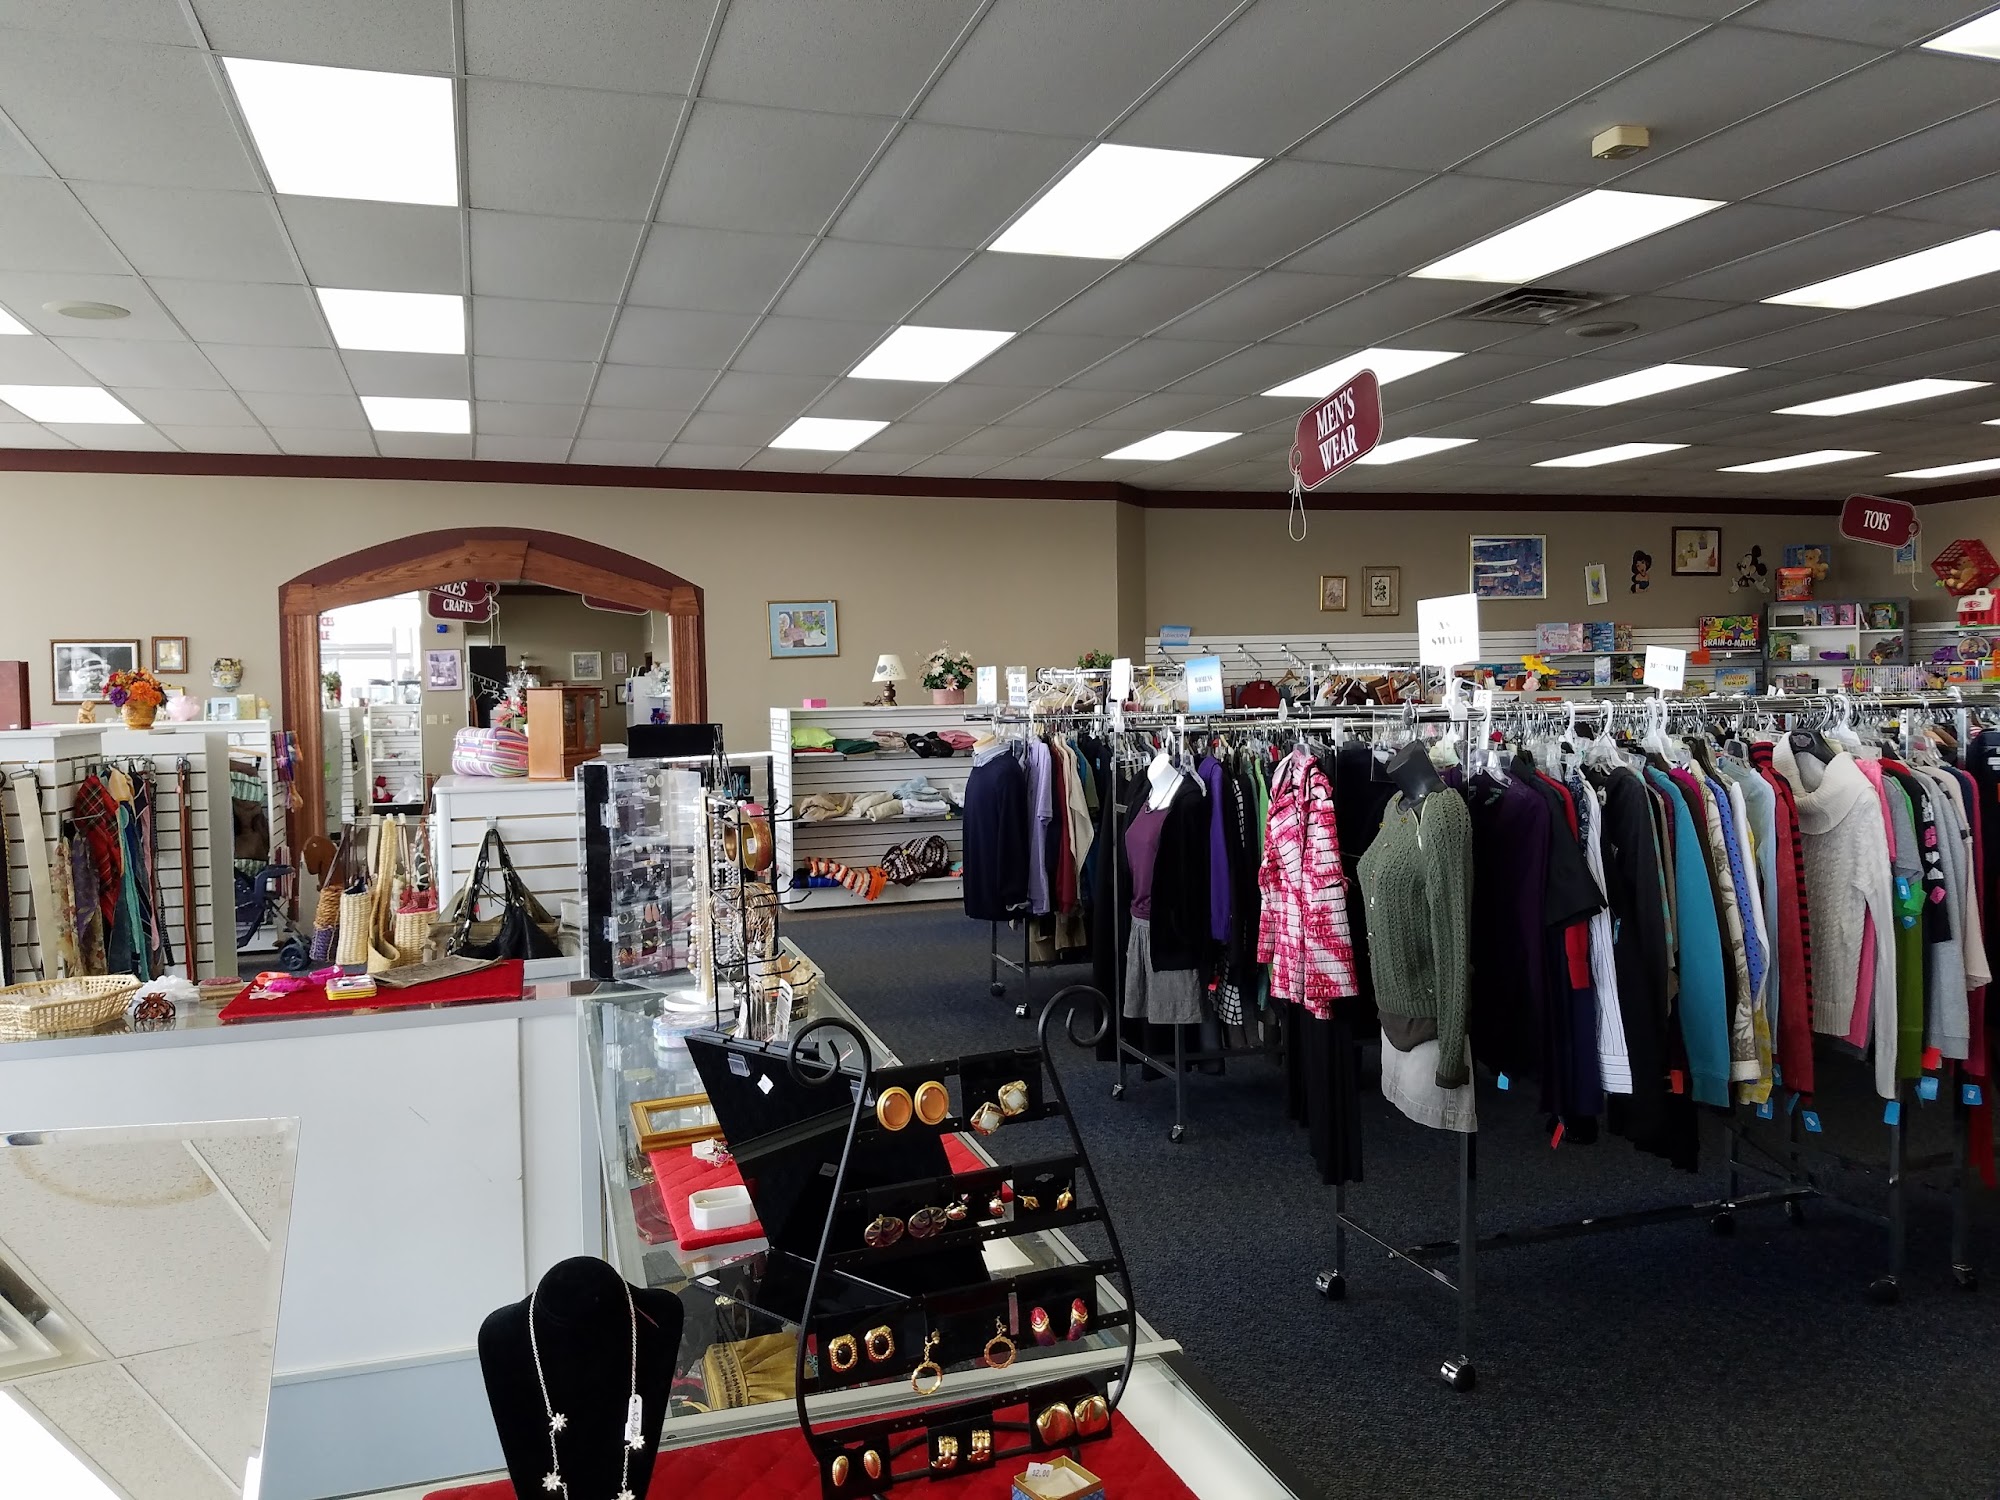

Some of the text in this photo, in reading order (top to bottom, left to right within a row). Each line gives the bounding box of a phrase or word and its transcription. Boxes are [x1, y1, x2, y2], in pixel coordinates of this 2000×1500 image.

[1315, 386, 1355, 441] MEN'S
[1318, 423, 1359, 472] WEAR
[1863, 509, 1891, 532] TOYS
[442, 598, 474, 613] CRAFTS
[1703, 638, 1757, 648] BRAIN-O-MATIC
[1031, 1469, 1051, 1478] $2.00
